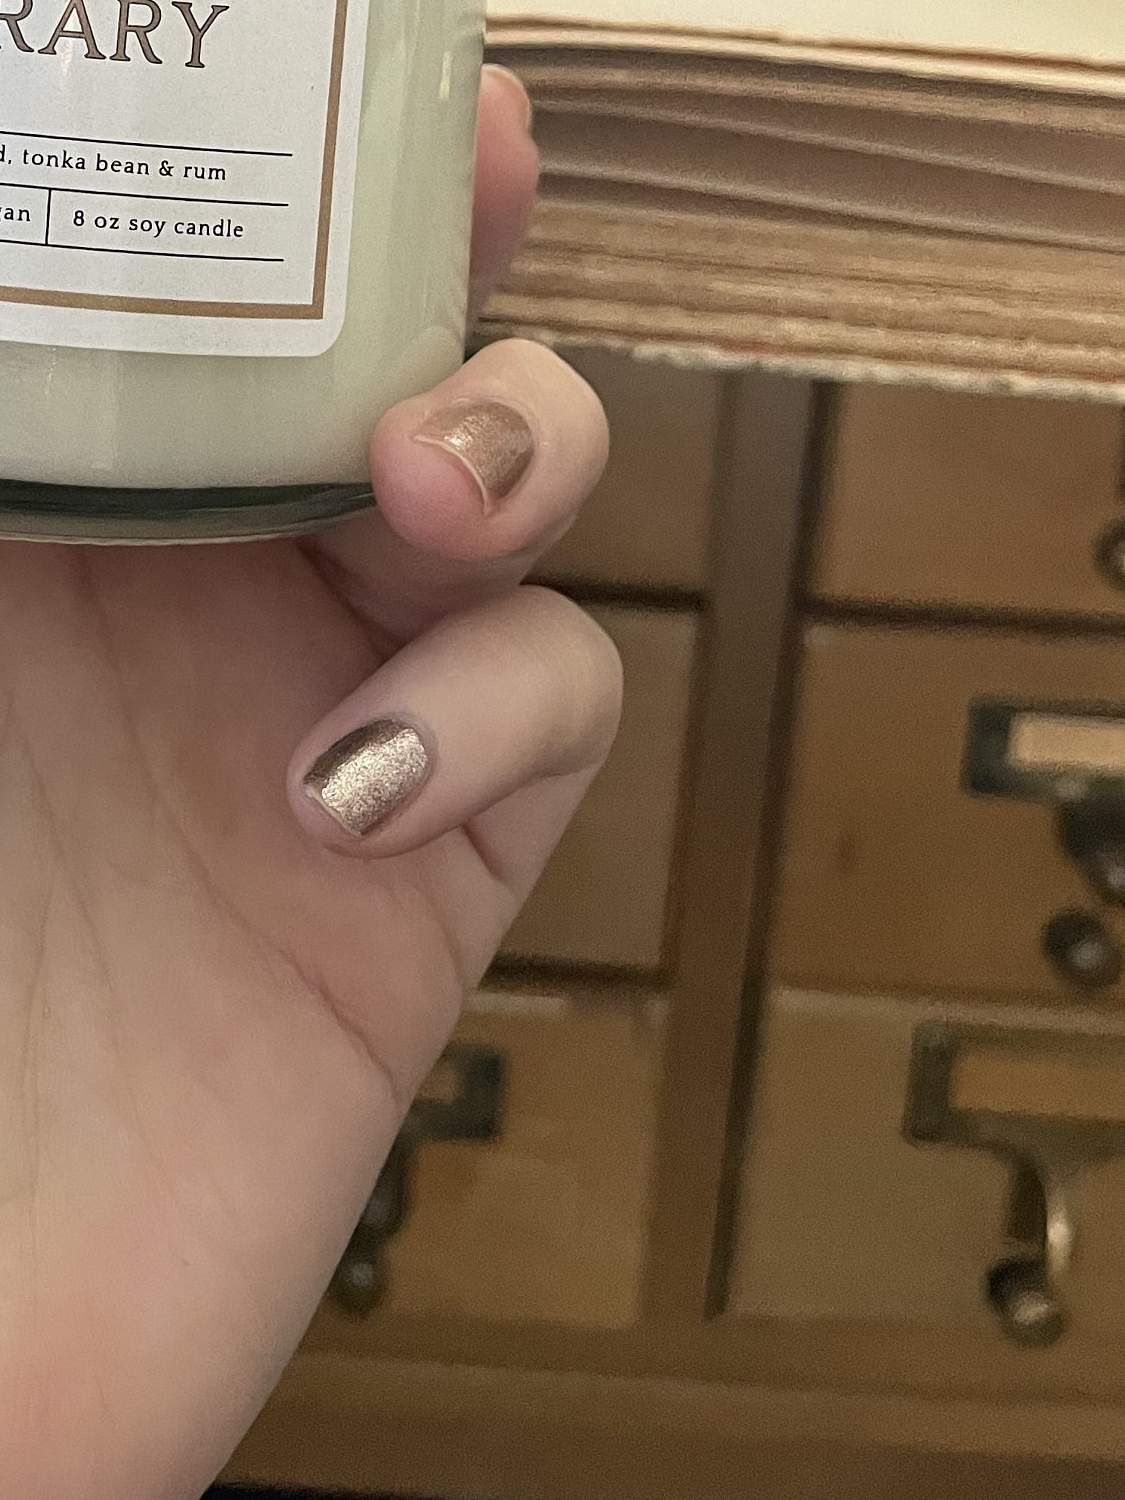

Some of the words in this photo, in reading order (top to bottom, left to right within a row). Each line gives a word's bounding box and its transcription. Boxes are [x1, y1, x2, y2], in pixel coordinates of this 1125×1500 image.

[23, 149, 86, 170] tonka
[96, 153, 149, 175] bean
[159, 160, 174, 177] &
[183, 165, 227, 181] rum
[73, 210, 84, 227] 8
[94, 216, 119, 229] oz
[129, 219, 166, 239] soy
[174, 218, 244, 238] candle
